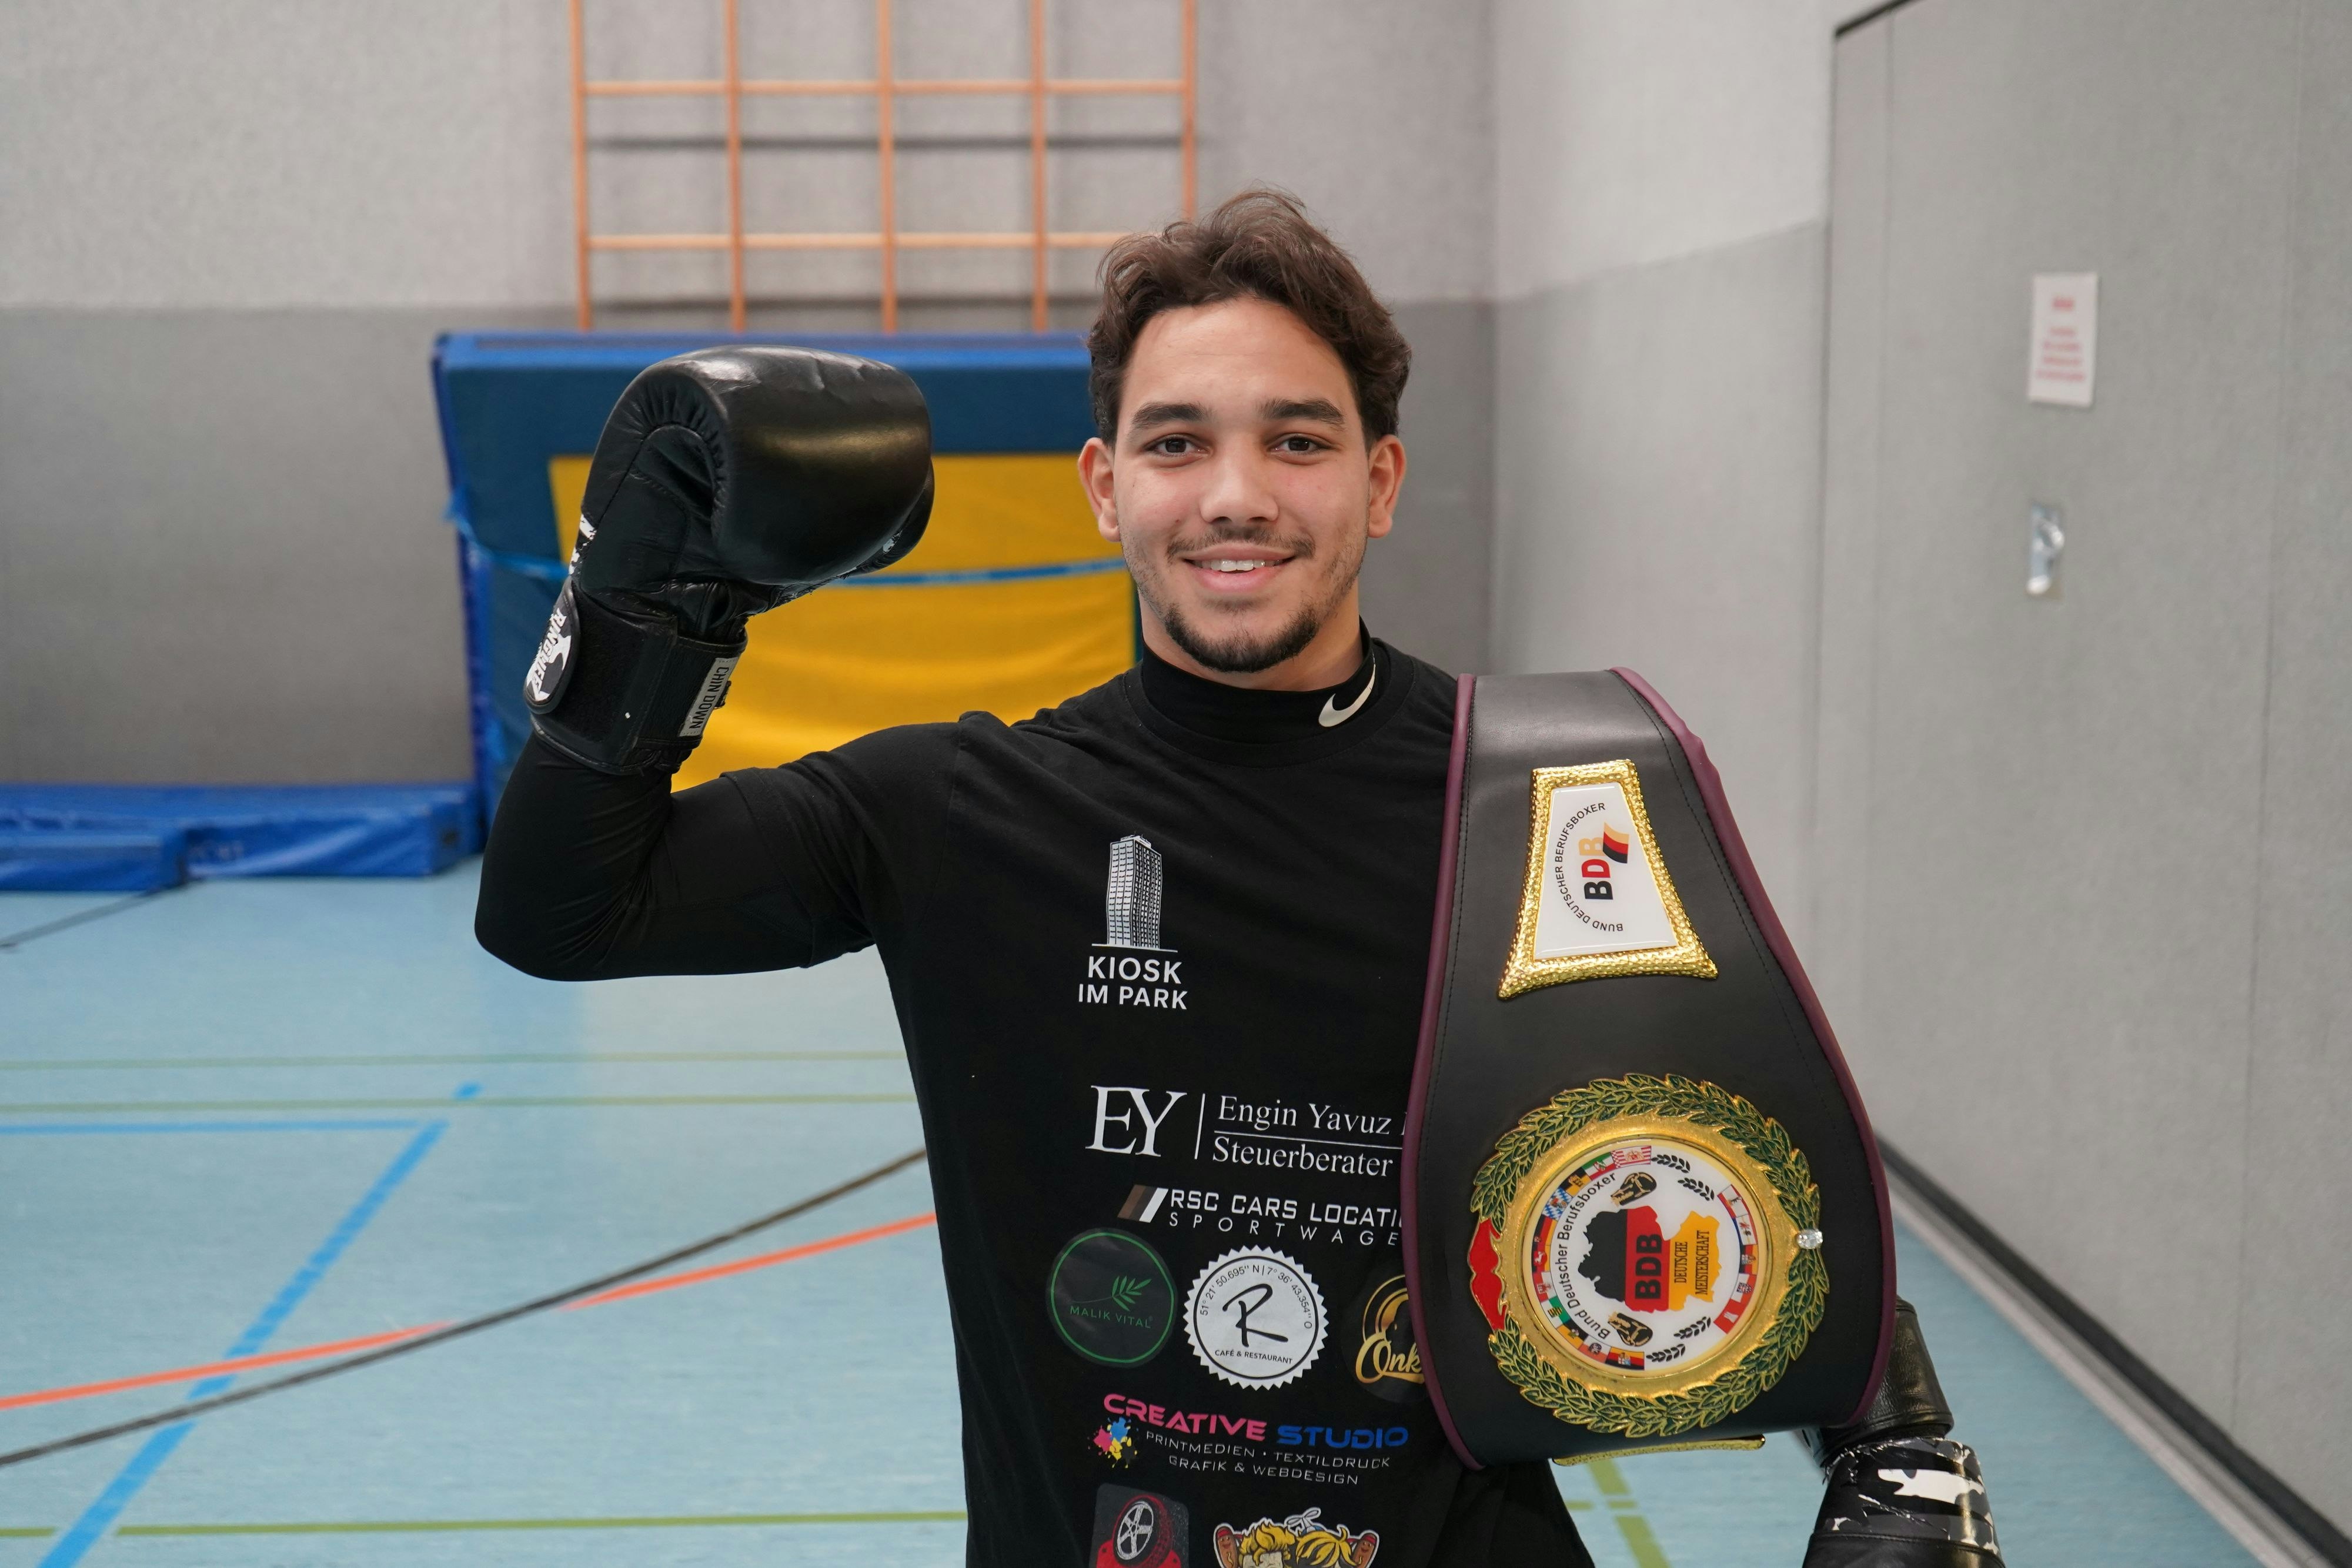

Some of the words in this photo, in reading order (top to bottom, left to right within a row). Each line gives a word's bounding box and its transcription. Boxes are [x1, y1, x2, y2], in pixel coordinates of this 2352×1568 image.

[707, 667, 729, 692] CHIN
[689, 696, 716, 728] DOWN
[1555, 803, 1605, 862] BERUFSBOXER
[1578, 837, 1613, 900] BDB
[1555, 866, 1591, 923] DEUTSCHER
[1592, 921, 1623, 931] BUND
[1088, 956, 1182, 984] KIOSK
[1078, 984, 1108, 1004] IM
[1119, 986, 1188, 1009] PARK
[1085, 1085, 1187, 1157] EY
[1218, 1095, 1297, 1130] Engin
[1309, 1103, 1392, 1135] Yavuz
[1212, 1136, 1394, 1176] Steuerberater
[1171, 1189, 1218, 1212] RSC
[1231, 1195, 1297, 1219] CARS
[1310, 1202, 1402, 1228] LOCATI
[1557, 1172, 1616, 1241] Berufsboxer
[1555, 1245, 1581, 1308] Deutscher
[1635, 1233, 1662, 1299] BDB
[1674, 1242, 1688, 1283] DEUTSCHE
[1695, 1230, 1709, 1295] MEISTERSCHAFT
[1070, 1305, 1110, 1320] MALIK
[1222, 1283, 1289, 1348] R
[1575, 1309, 1611, 1340] Bund
[1215, 1349, 1234, 1357] CAFÉ
[1244, 1351, 1293, 1365] RESTAURANT
[1103, 1393, 1268, 1442] CREATIVE
[1277, 1425, 1408, 1449] STUDIO
[1147, 1431, 1255, 1457] PRINTMEDIEN
[1274, 1451, 1390, 1469] TEXTILDRUCK
[1170, 1456, 1227, 1472] GRAFIK
[1234, 1462, 1246, 1473] &
[1254, 1465, 1359, 1485] WEBDESIGN
